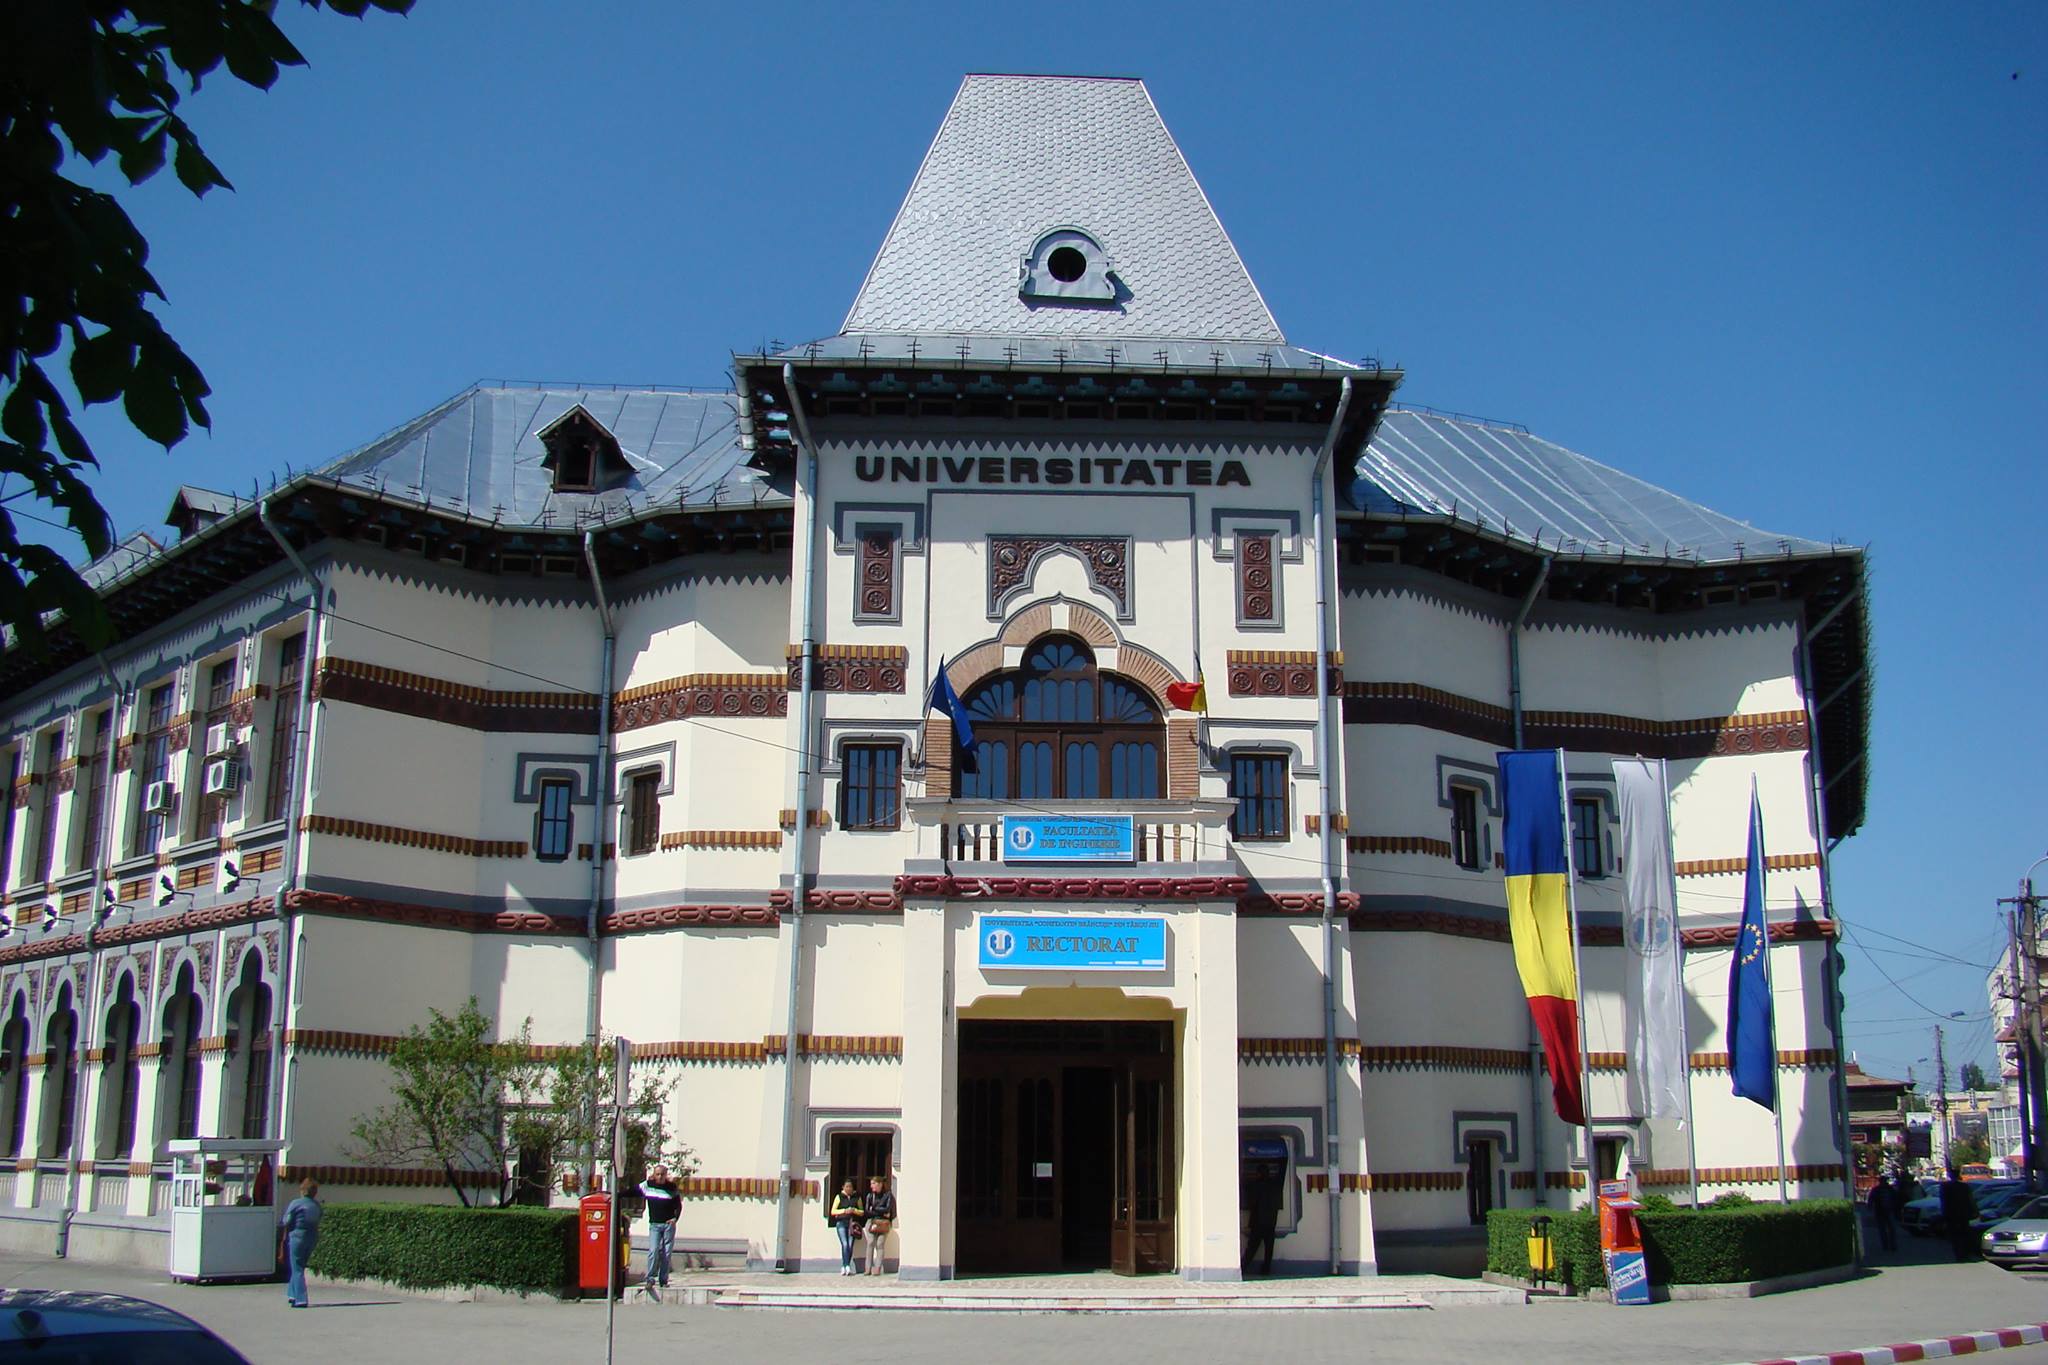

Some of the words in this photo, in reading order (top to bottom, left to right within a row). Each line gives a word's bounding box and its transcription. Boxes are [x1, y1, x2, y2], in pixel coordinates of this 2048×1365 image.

[855, 455, 1252, 486] UNIVERSITATEA
[1043, 826, 1118, 836] FACULTATEA
[1027, 936, 1139, 953] RECTORAT
